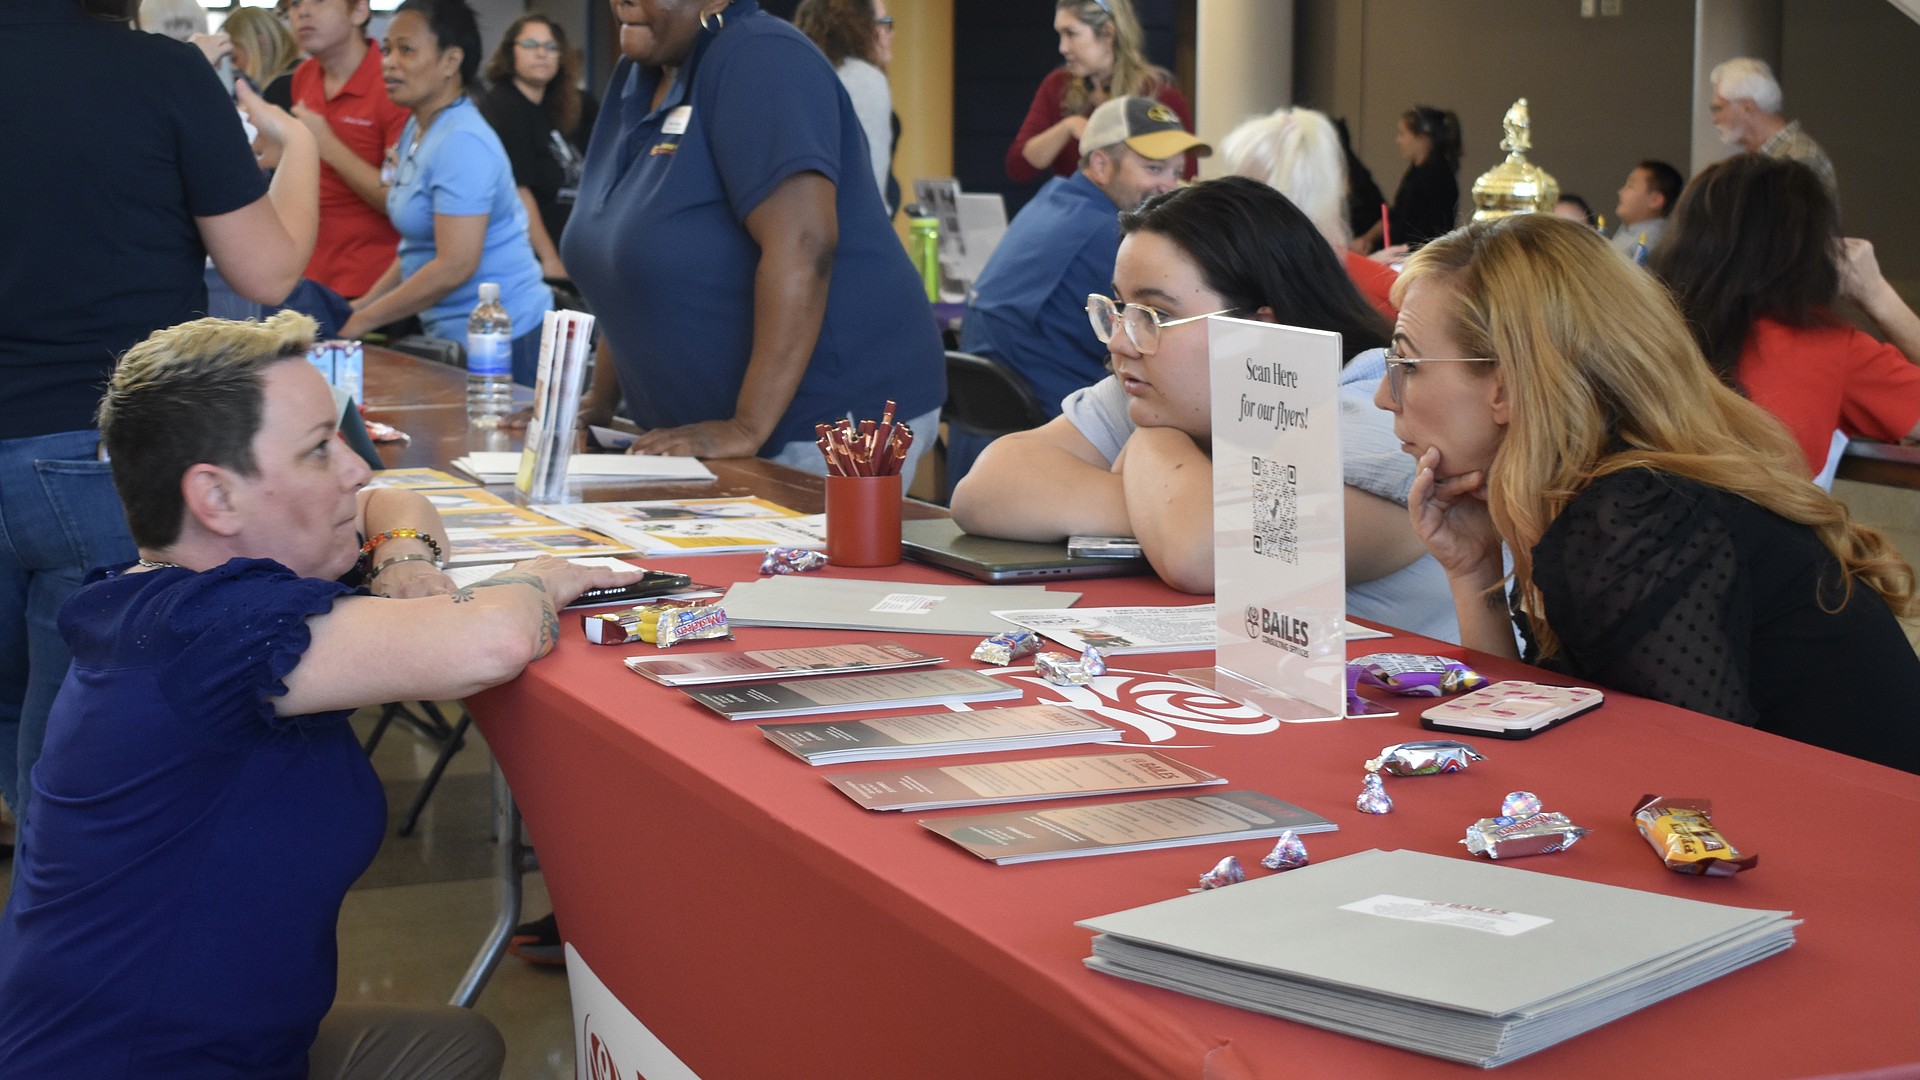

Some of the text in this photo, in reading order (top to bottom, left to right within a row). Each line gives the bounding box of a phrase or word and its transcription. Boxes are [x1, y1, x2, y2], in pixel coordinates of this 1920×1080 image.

[1246, 358, 1298, 388] Scan Here
[1238, 393, 1309, 431] for our flyers!
[676, 614, 720, 636] Musketeers
[1262, 608, 1309, 647] BAILES
